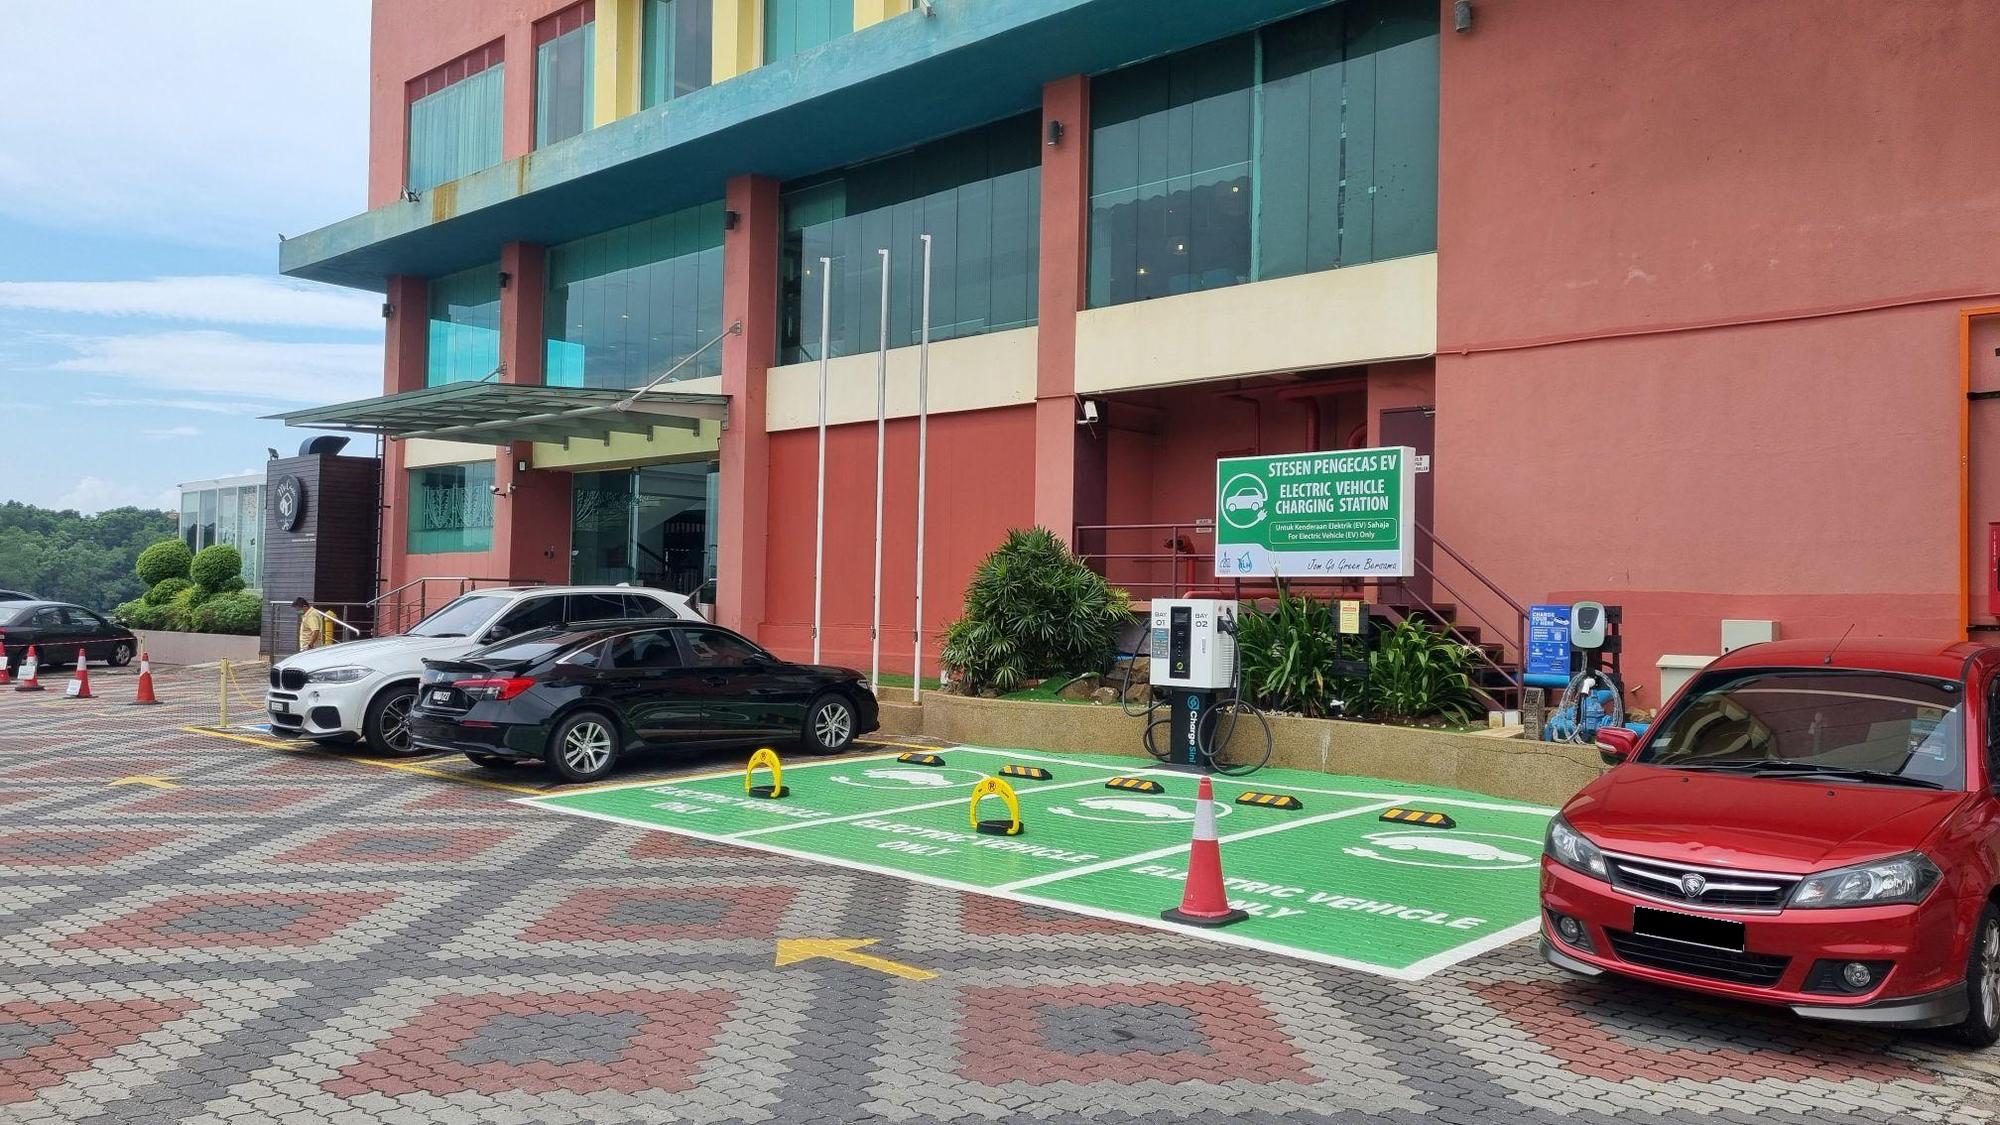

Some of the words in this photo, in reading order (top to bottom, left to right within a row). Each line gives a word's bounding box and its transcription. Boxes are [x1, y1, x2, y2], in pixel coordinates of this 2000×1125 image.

[1268, 461, 1311, 477] STESEN
[1314, 457, 1377, 475] PENGECAS
[1380, 455, 1397, 471] EV
[1280, 481, 1330, 498] ELECTRIC
[1335, 479, 1385, 495] VEHICLE
[1275, 498, 1334, 514] CHARGING
[1339, 496, 1389, 512] STATION
[1295, 523, 1327, 531] Kenderaan
[1328, 522, 1352, 530] Elektrik
[1353, 522, 1367, 530] (EV)
[1367, 521, 1389, 530] Sahaja
[1299, 532, 1321, 540] Electric
[1345, 531, 1359, 540] (EV)
[1359, 531, 1375, 540] Only
[1339, 557, 1360, 574] Green
[1364, 557, 1397, 571] Bersama
[850, 819, 977, 842] ELECTRIC
[973, 838, 1100, 863] VEHICLE
[876, 841, 961, 856] ONLY
[1129, 865, 1306, 898] ELETRIC
[1306, 891, 1488, 931] VEHICLE
[1227, 897, 1307, 919] NLY
